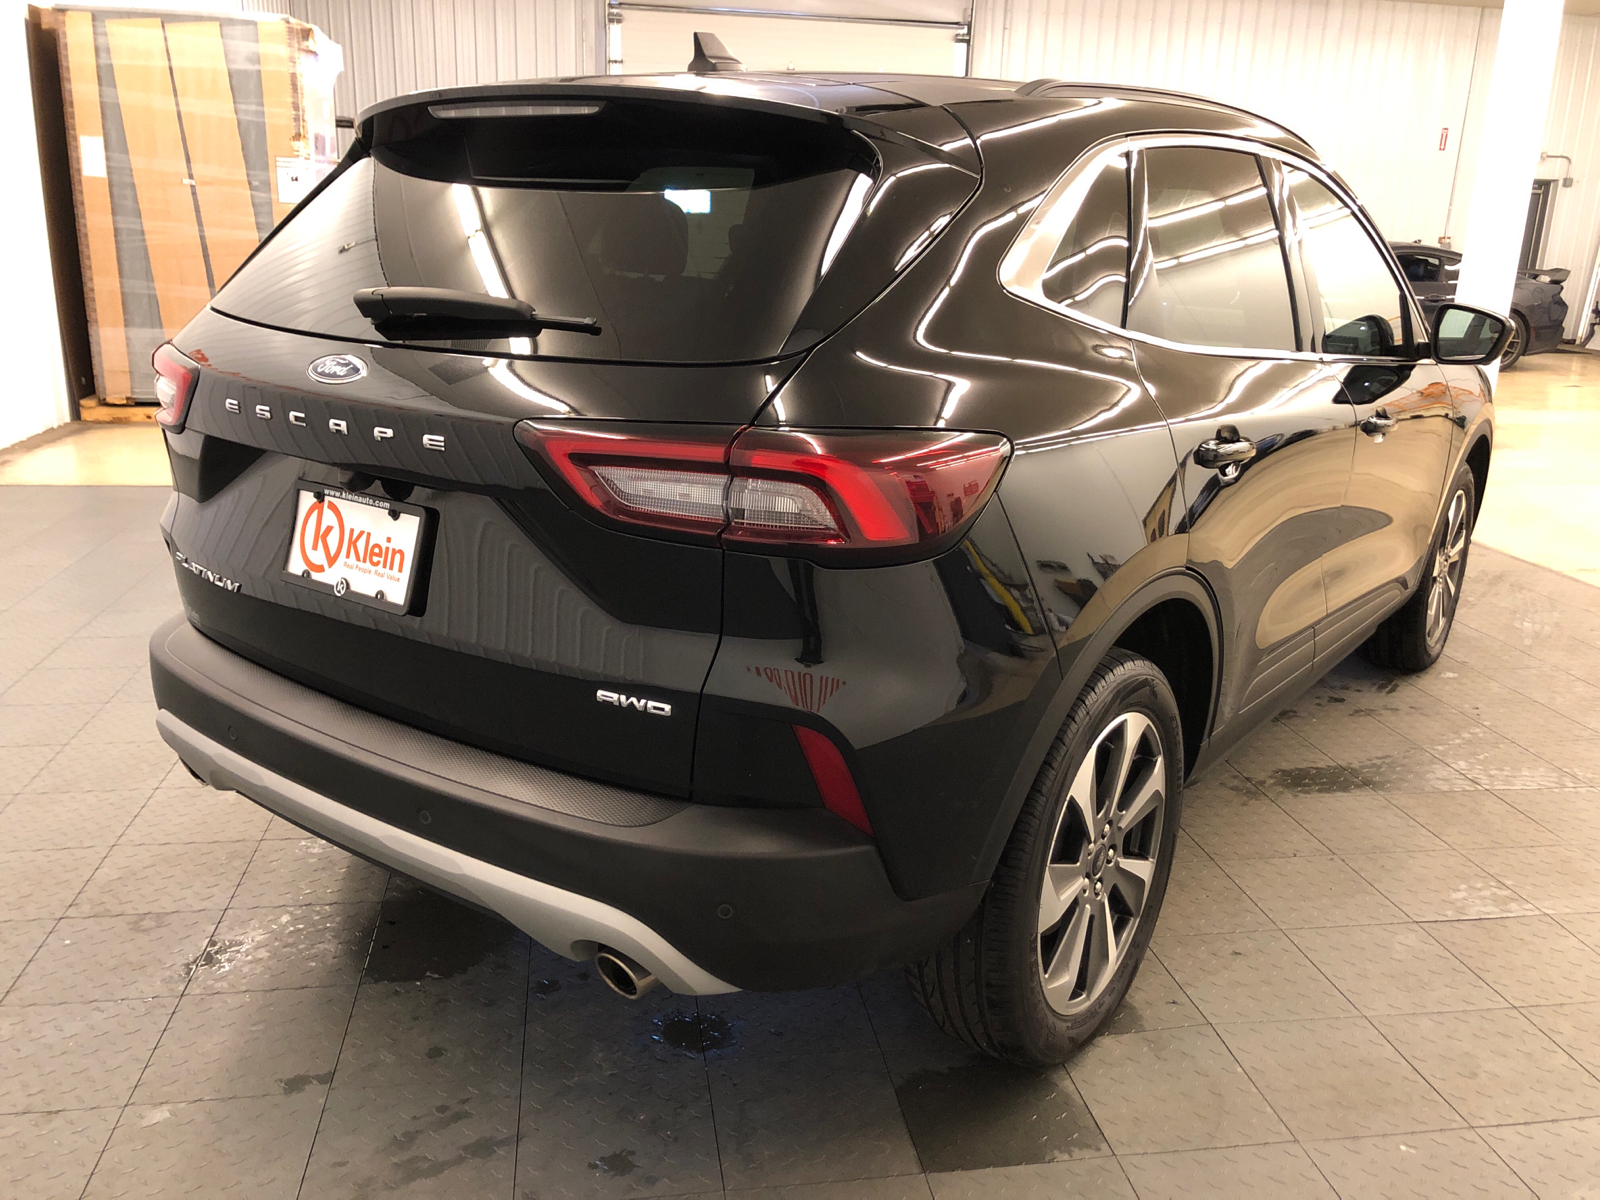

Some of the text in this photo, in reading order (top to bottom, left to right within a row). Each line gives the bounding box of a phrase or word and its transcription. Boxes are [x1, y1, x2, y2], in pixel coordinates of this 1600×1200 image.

[316, 357, 355, 377] Ford
[224, 397, 446, 452] ESCAPE
[323, 488, 391, 510] www.kleinauto.com
[345, 527, 405, 574] Klein
[175, 551, 240, 593] PLATINUM
[343, 561, 355, 570] Real
[373, 570, 386, 579] Real
[595, 689, 673, 717] AWD
